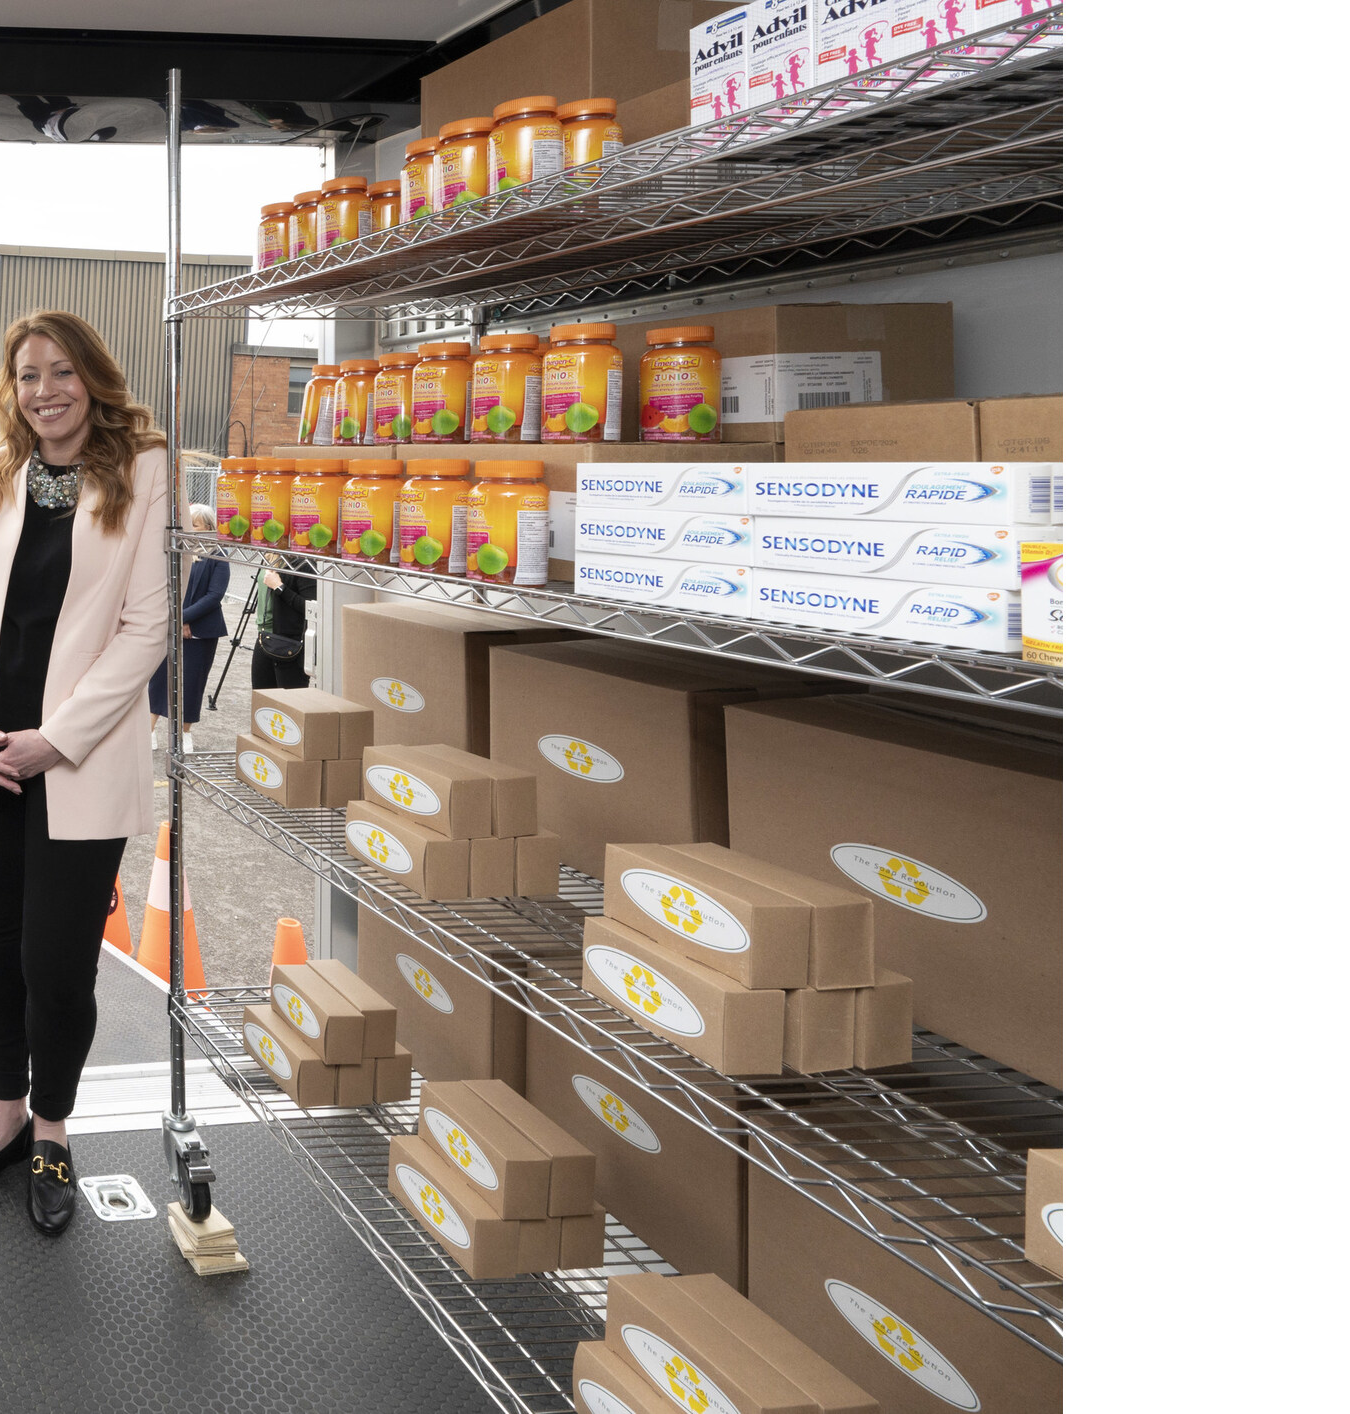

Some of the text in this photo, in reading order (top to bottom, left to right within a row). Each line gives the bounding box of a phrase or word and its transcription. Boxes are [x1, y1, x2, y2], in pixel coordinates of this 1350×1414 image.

[821, 0, 887, 25] Adv
[750, 5, 807, 42] Advil
[752, 38, 773, 53] pour
[774, 24, 807, 44] enfants
[692, 31, 743, 65] Advil
[694, 49, 743, 76] pour enfants
[654, 358, 697, 367] Emergen-C
[654, 373, 697, 382] JUNIOR
[581, 479, 663, 493] SENSODYNE
[679, 486, 719, 495] RAPIDE
[755, 482, 879, 499] SENSODYNE
[905, 489, 968, 501] RAPIDE
[580, 523, 666, 541] SENSODYNE
[683, 534, 725, 545] RAPIDE
[762, 535, 885, 558] SENSODYNE
[916, 545, 967, 558] RAPID
[580, 567, 664, 588] SENSODYNE
[680, 583, 722, 595] RAPIDE
[759, 587, 880, 615] SENSODYNE
[910, 603, 960, 619] RAPID
[927, 615, 952, 623] RELIEF
[1025, 639, 1050, 649] GELATIN
[1026, 651, 1037, 660] 60
[854, 855, 957, 899] The Soap Revolution
[640, 881, 726, 928] The Soap Revolution
[605, 958, 683, 1012] The Soap Revolution
[850, 1298, 951, 1382] The Soap Revolution
[642, 1341, 658, 1356] The
[660, 1355, 681, 1377] Soap
